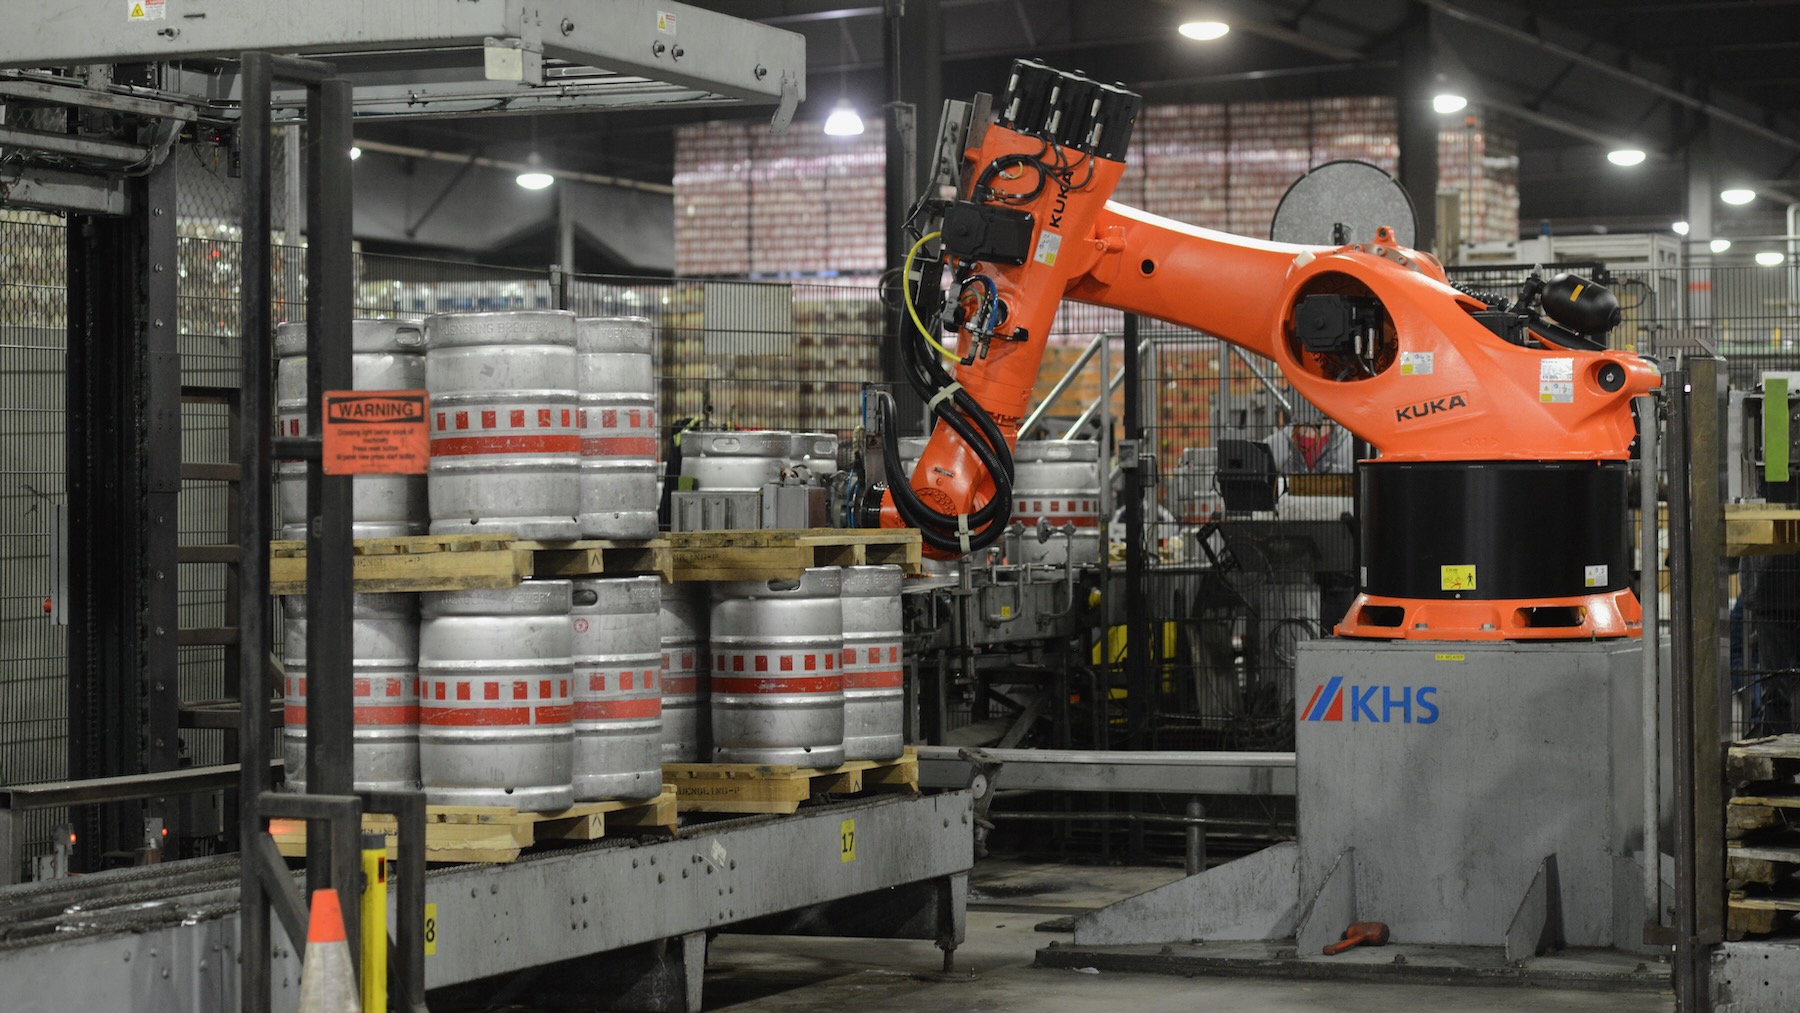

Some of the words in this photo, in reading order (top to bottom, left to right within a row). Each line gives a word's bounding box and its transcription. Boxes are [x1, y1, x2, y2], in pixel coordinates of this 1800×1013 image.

[1049, 171, 1074, 228] KUKA
[497, 320, 549, 334] BREWERY
[338, 402, 413, 417] WARNING
[1396, 394, 1467, 423] KUKA
[1351, 685, 1440, 725] KHS
[676, 786, 740, 797] UENGLING-P
[842, 831, 854, 853] 17
